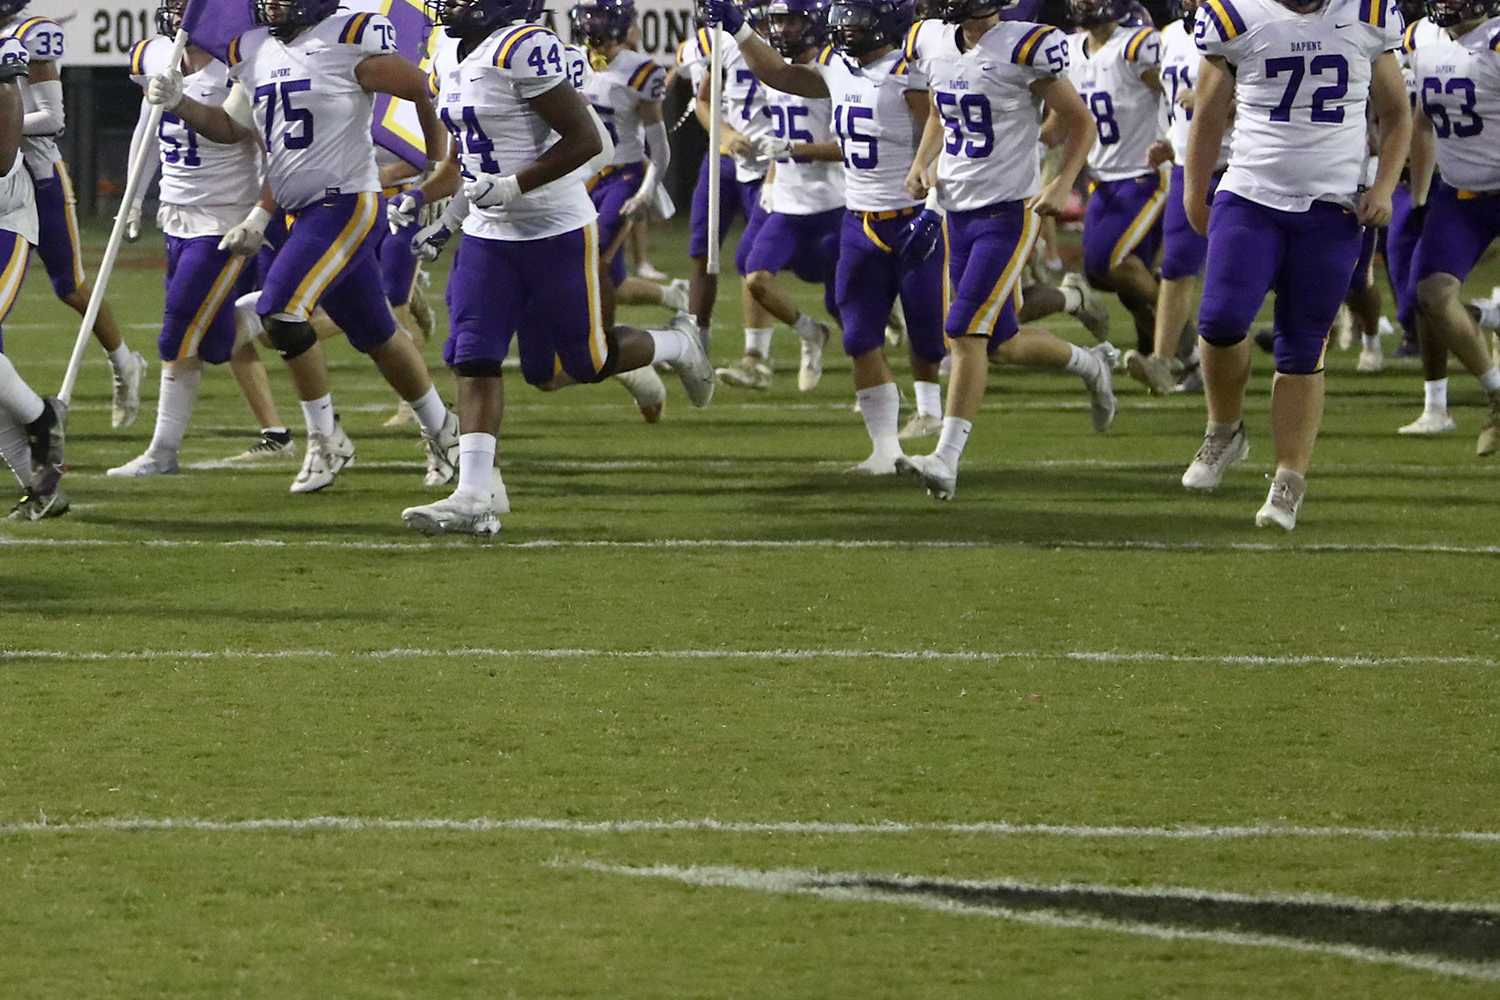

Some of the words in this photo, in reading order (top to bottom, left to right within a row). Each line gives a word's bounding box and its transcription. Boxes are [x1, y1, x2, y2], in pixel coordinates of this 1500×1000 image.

[35, 31, 64, 56] 33
[93, 8, 149, 54] 201
[1290, 41, 1322, 52] DAPHNE
[527, 43, 563, 77] 44
[1265, 53, 1349, 123] 72
[1422, 77, 1484, 138] 63
[254, 78, 314, 153] 75
[936, 91, 995, 159] 59
